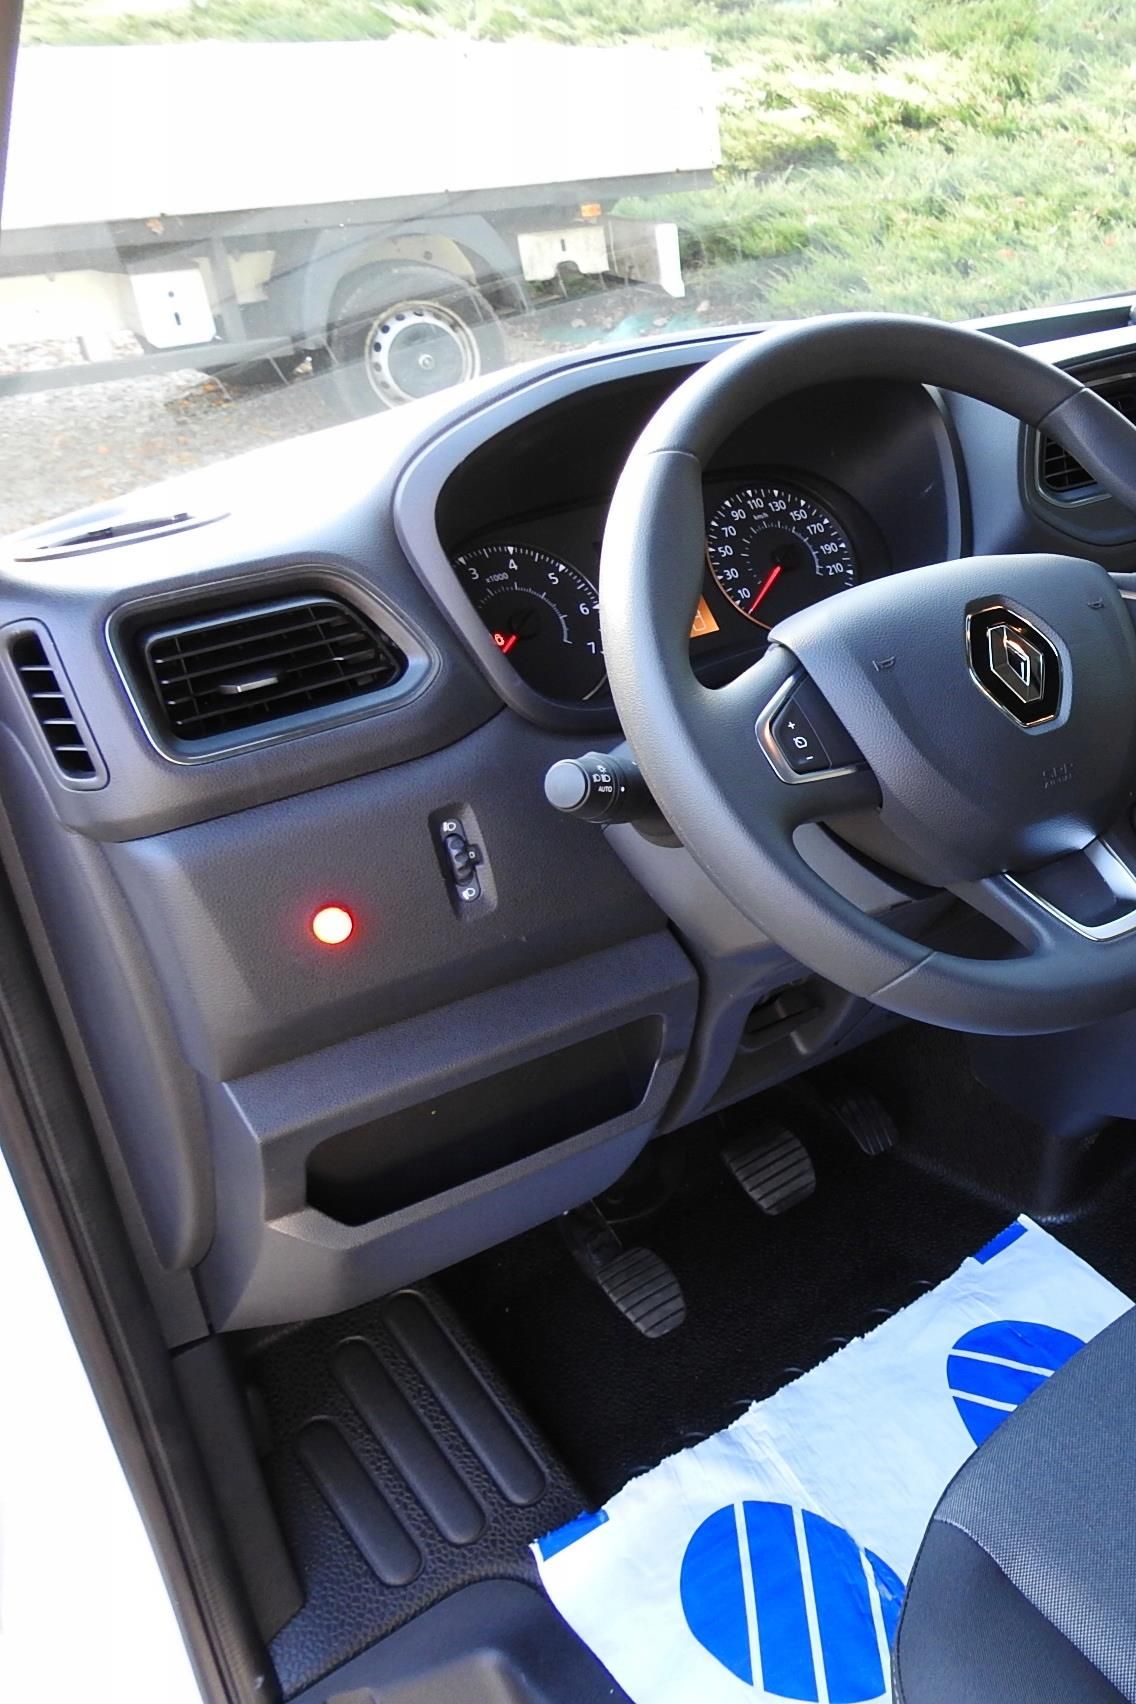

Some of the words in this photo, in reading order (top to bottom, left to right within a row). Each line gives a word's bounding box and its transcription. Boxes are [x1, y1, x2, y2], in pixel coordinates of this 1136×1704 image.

[747, 498, 764, 510] 110
[768, 499, 787, 512] 130
[731, 508, 746, 521] 90
[753, 512, 769, 521] km/h
[789, 509, 808, 522] 150
[722, 525, 737, 538] 70
[807, 522, 824, 536] 170
[718, 544, 734, 558] 50
[820, 542, 838, 555] 190
[508, 559, 518, 570] 4
[826, 562, 844, 576] 210
[468, 567, 479, 580] 3
[548, 573, 559, 585] 5
[723, 567, 739, 581] 30
[737, 587, 751, 600] 10
[579, 603, 590, 615] 6
[587, 642, 596, 654] 7
[598, 785, 612, 793] AUTO
